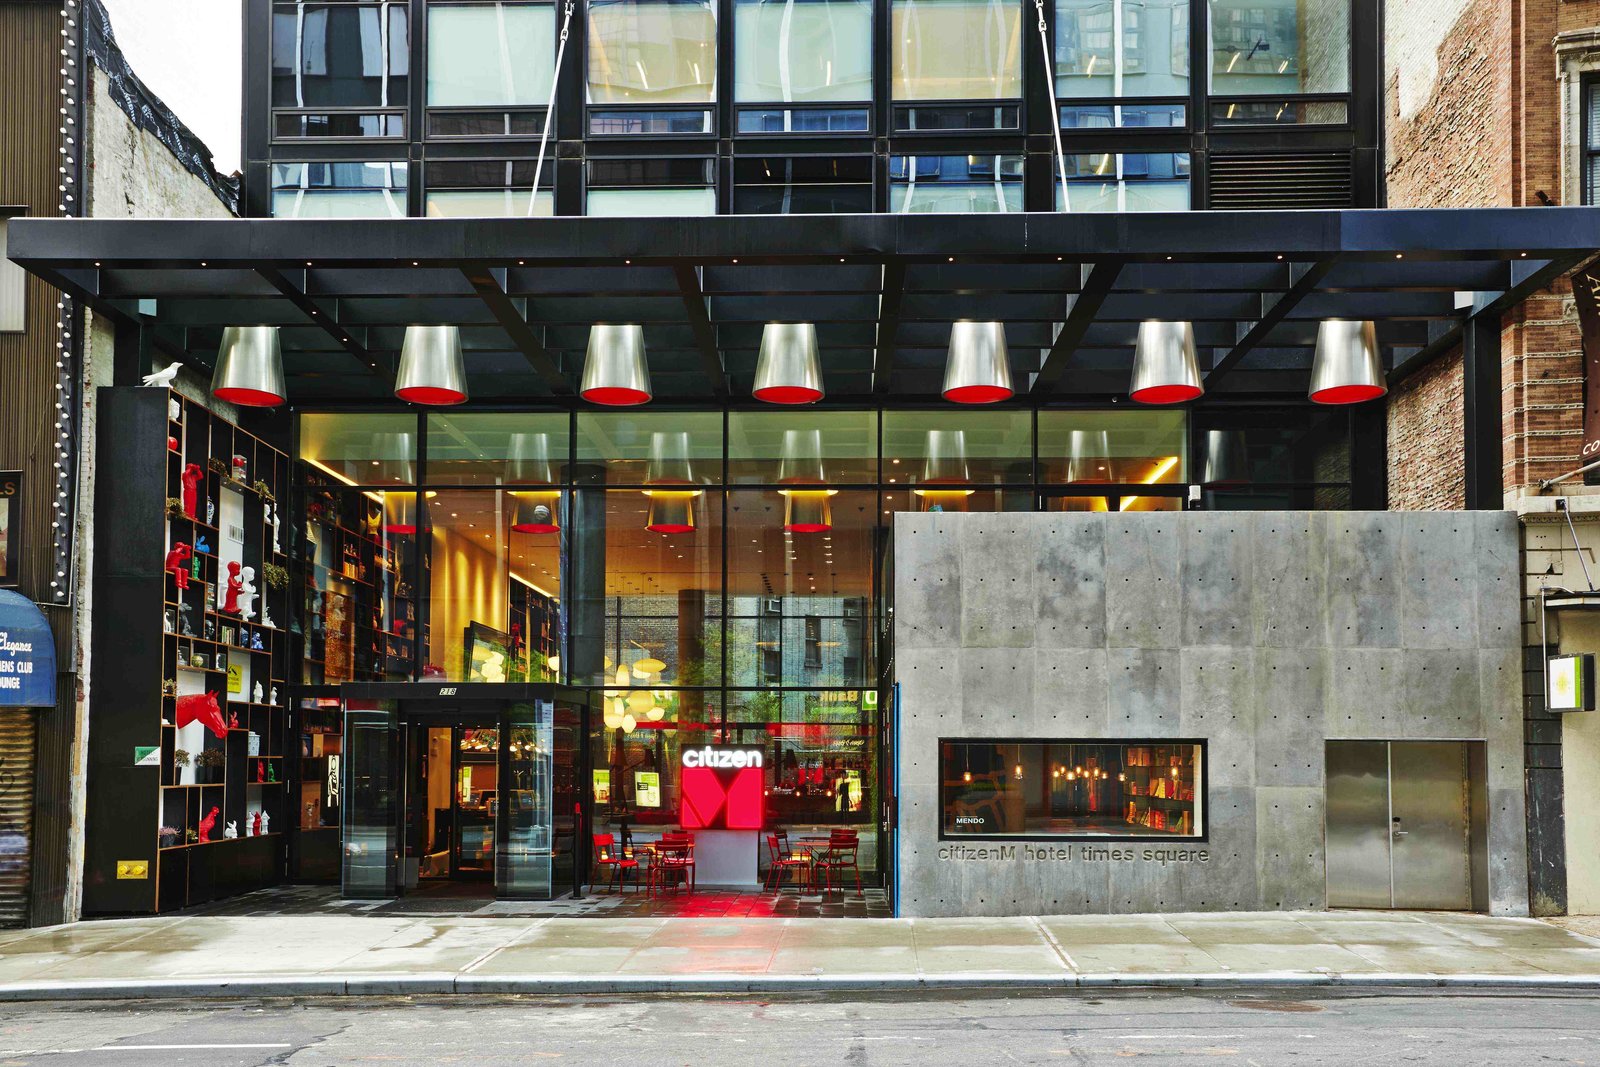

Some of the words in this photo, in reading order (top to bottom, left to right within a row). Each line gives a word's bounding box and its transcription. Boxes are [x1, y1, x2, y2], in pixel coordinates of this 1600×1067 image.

[17, 661, 33, 674] CLUB
[440, 687, 456, 695] 218
[682, 745, 763, 768] citizen
[938, 845, 1016, 861] citizenM
[1024, 844, 1073, 861] hotel
[1081, 846, 1135, 861] times
[1142, 848, 1209, 867] square
